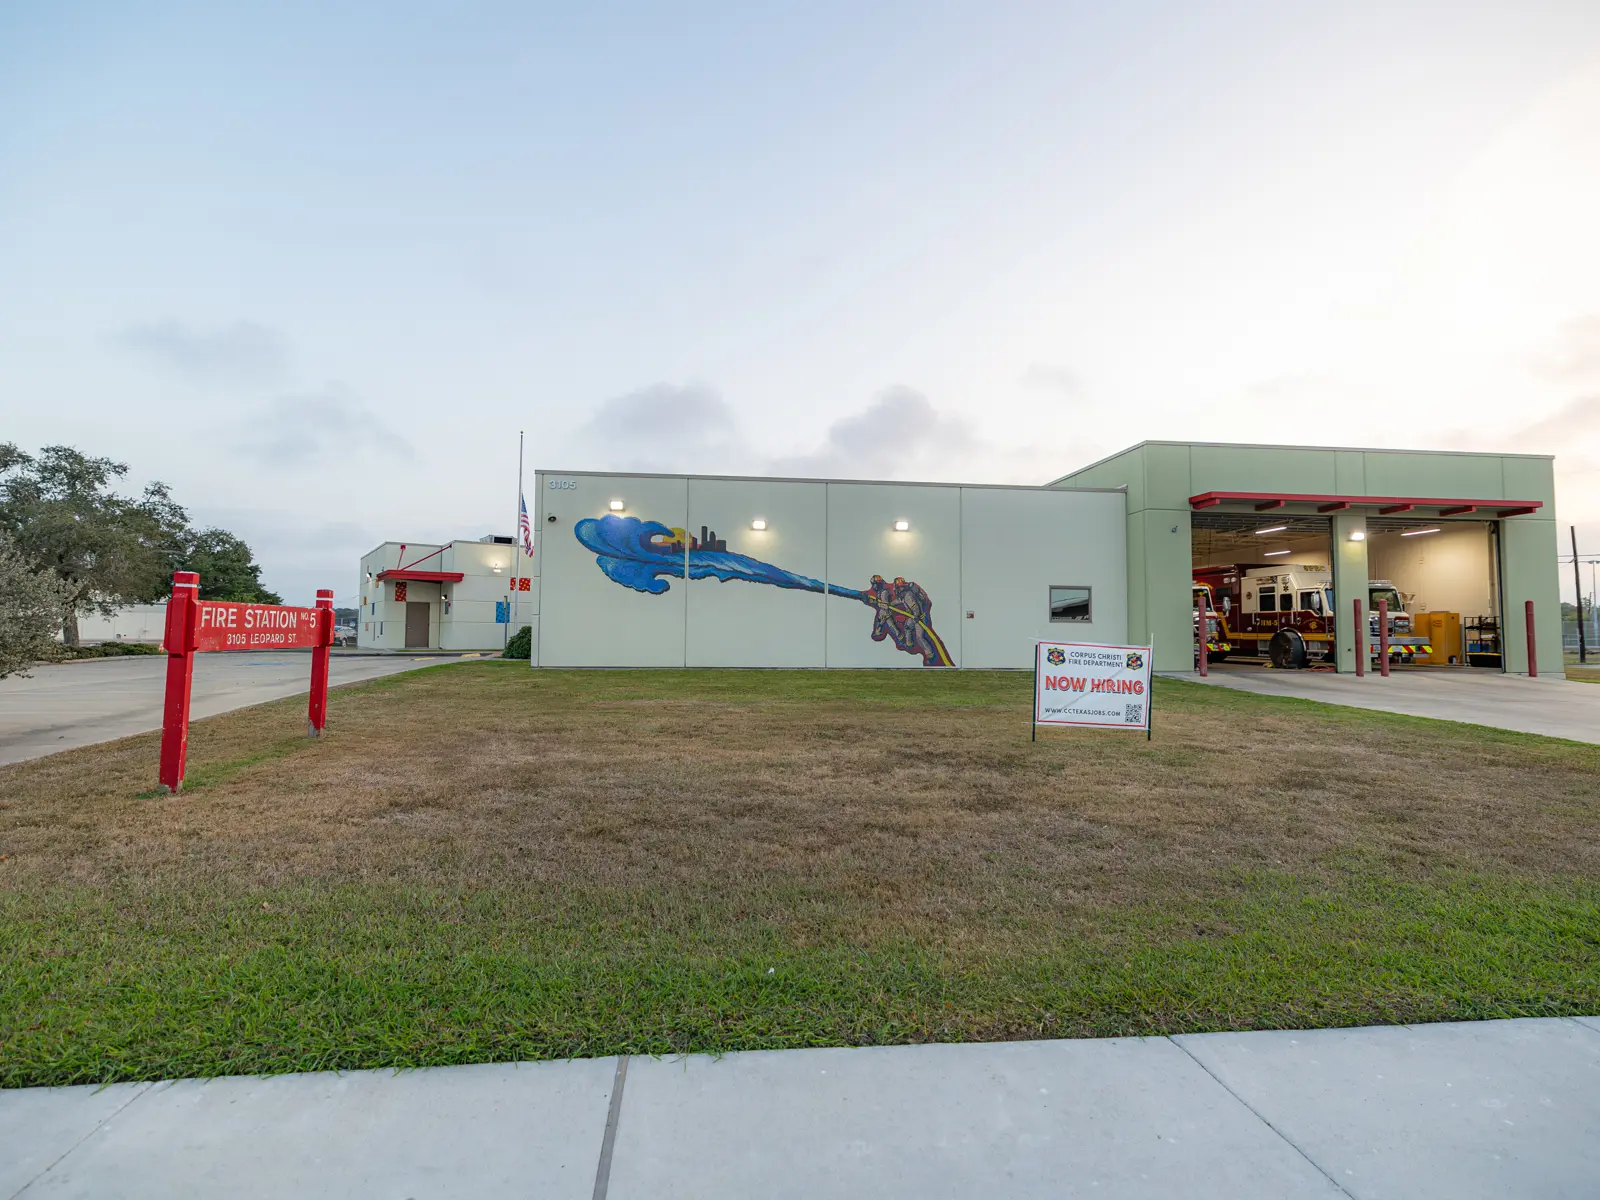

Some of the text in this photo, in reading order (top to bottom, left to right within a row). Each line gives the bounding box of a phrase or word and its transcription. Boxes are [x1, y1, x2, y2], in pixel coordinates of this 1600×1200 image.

[549, 480, 576, 490] 3105
[201, 607, 237, 628] FIRE
[244, 609, 297, 628] STATION
[309, 612, 317, 629] 5
[226, 633, 298, 645] 3105 LEOPARD ST.
[1083, 659, 1124, 668] DEPARTMENT
[1045, 675, 1144, 696] NOW HIRING
[1045, 708, 1121, 717] WWW.CCTEXASJOBS.COM
